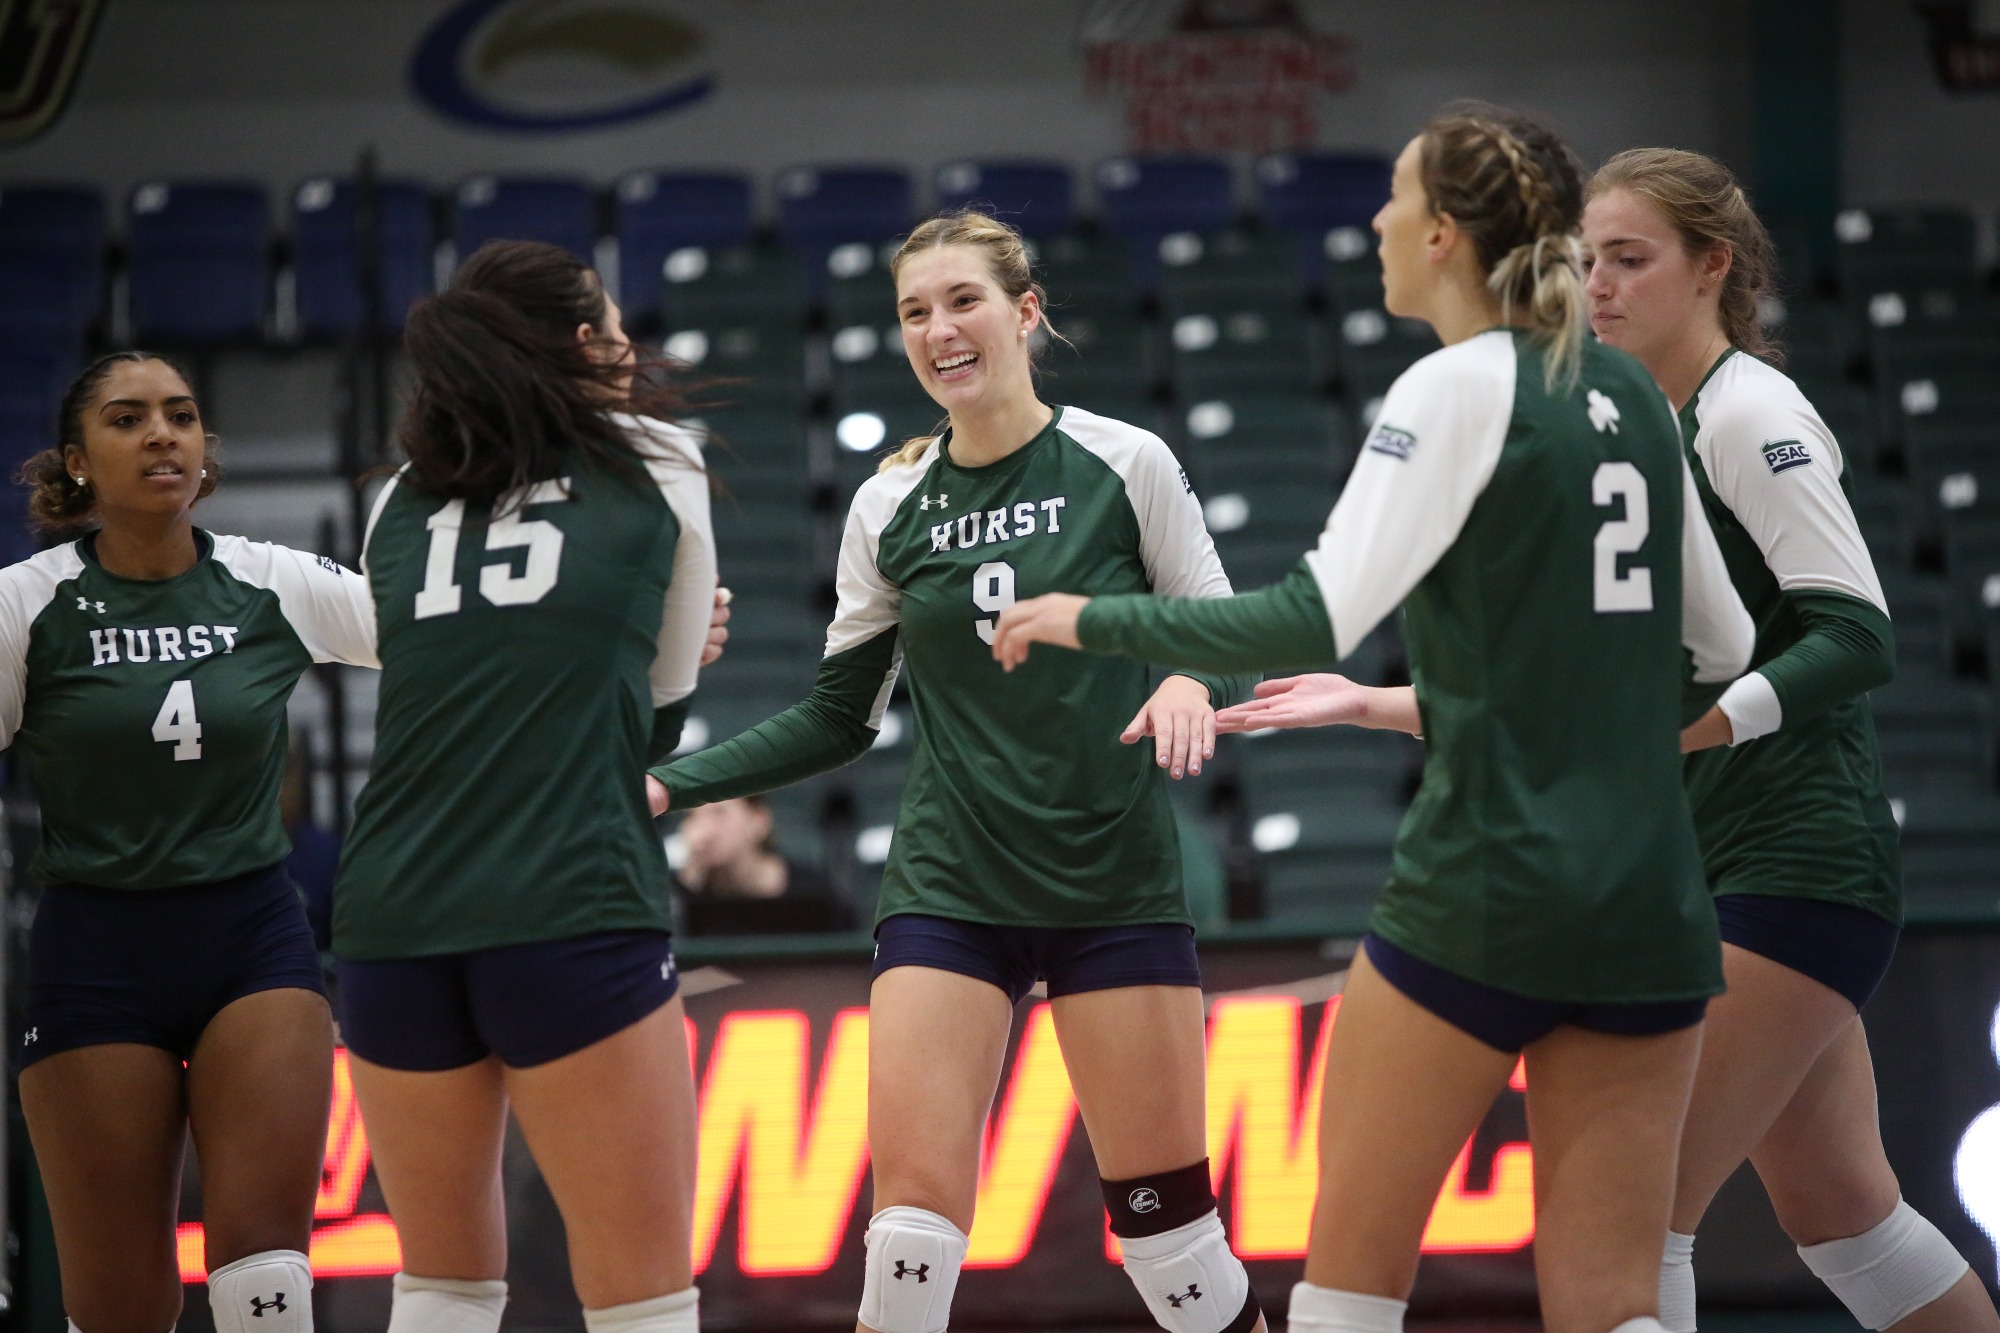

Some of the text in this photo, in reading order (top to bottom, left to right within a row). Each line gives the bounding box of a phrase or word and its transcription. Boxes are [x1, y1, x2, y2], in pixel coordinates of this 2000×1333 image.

[1765, 445, 1810, 467] PSAC
[415, 475, 572, 620] 15
[930, 497, 1066, 553] HURST
[1591, 461, 1654, 613] 2
[972, 561, 1016, 646] 9
[89, 624, 239, 667] HURST
[151, 679, 203, 762] 4
